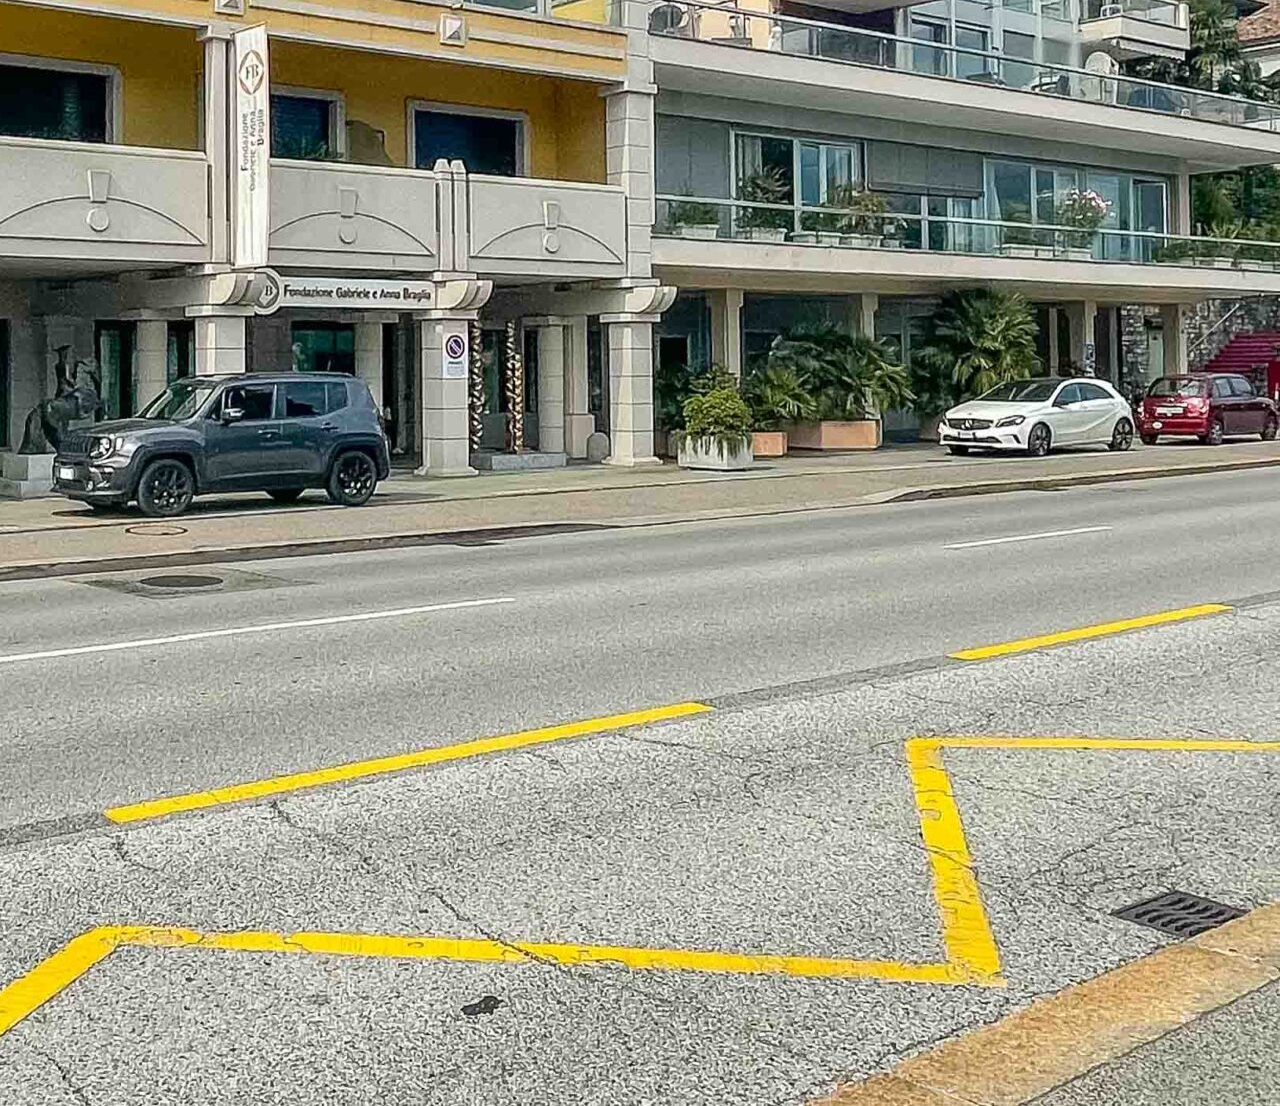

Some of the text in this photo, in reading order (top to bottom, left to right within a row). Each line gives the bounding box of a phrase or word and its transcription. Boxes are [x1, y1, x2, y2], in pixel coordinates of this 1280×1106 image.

[240, 112, 249, 172] Fondazione
[283, 284, 334, 298] Fondazione
[335, 287, 371, 300] Gabriele
[379, 289, 401, 300] Anna
[403, 288, 431, 303] Braglia
